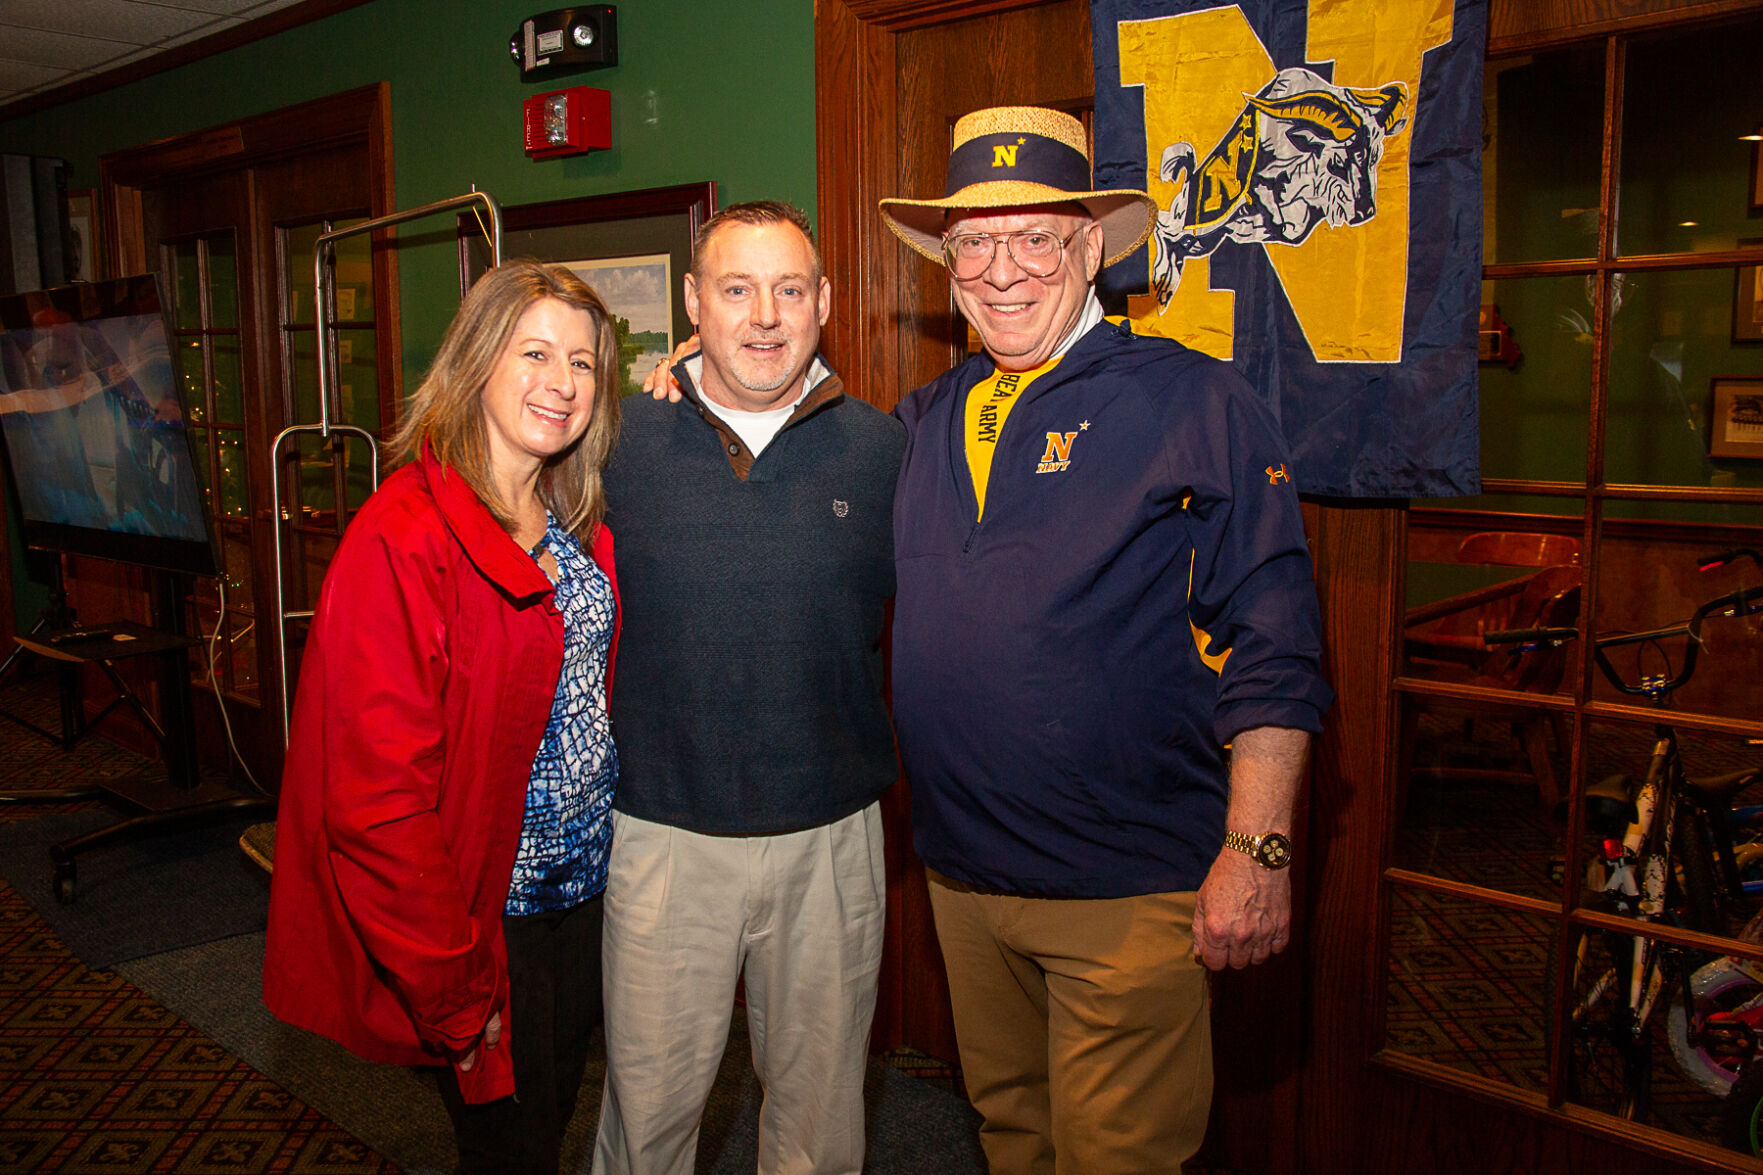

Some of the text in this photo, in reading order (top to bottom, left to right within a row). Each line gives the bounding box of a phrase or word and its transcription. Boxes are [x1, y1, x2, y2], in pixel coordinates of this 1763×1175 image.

[992, 145, 1019, 167] N
[1204, 130, 1242, 212] N
[1117, 0, 1455, 363] N
[978, 405, 998, 443] ARMY
[1041, 432, 1078, 462] N
[1036, 460, 1071, 473] NAVY
